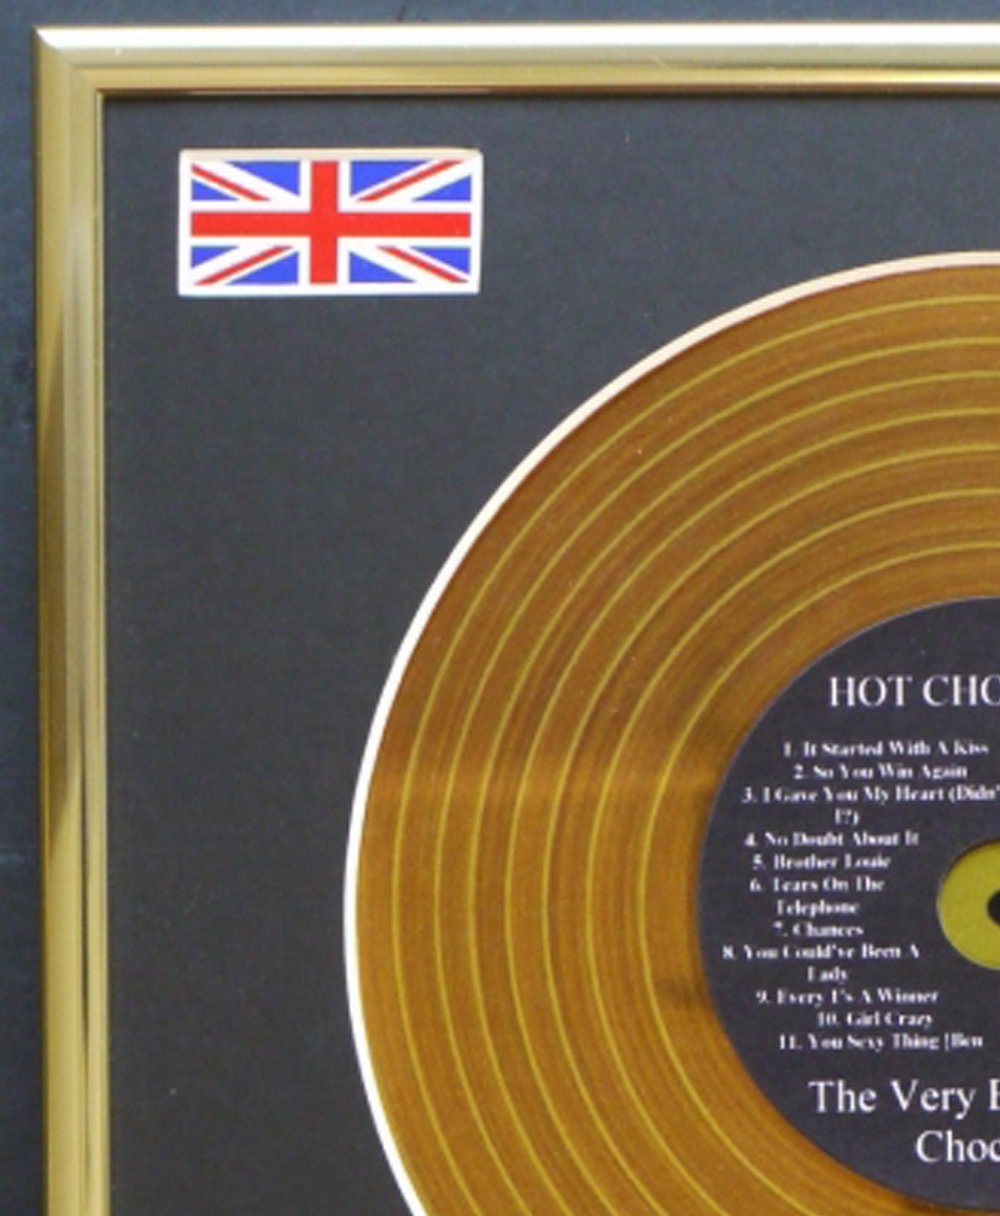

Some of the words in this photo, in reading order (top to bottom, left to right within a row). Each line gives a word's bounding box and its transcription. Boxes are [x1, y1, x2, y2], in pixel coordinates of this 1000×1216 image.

[829, 675, 913, 707] HOT
[804, 741, 815, 756] It
[822, 740, 882, 756] Started
[888, 740, 929, 756] With
[937, 740, 948, 756] A
[953, 739, 989, 755] Kiss
[813, 764, 833, 780] So
[840, 764, 873, 779] You
[878, 763, 913, 779] Win
[918, 763, 967, 780] Again
[763, 788, 770, 803] I
[774, 787, 817, 803] Gave
[823, 787, 858, 802] You
[864, 787, 889, 805] My
[896, 786, 944, 801] Heart
[764, 832, 788, 847] No
[793, 831, 843, 847] Doubt
[851, 831, 898, 846] About
[905, 830, 919, 846] It
[773, 854, 837, 870] Brother
[845, 854, 891, 869] Louie
[773, 877, 819, 892] Tears
[822, 876, 849, 892] On
[856, 875, 886, 892] The
[777, 900, 859, 918] Telephone
[793, 921, 864, 937] Chances
[743, 945, 778, 960] You
[783, 943, 855, 960] Could've
[862, 943, 901, 959] Been
[909, 943, 919, 959] A
[807, 966, 848, 985] Lady
[777, 988, 823, 1008] Every
[861, 988, 872, 1004] A
[877, 987, 939, 1004] Winner
[847, 1011, 880, 1027] Girl
[884, 1011, 933, 1030] Crazy
[807, 1034, 842, 1049] You
[847, 1034, 884, 1052] Sexy
[892, 1032, 939, 1050] Thing
[808, 1079, 878, 1114] The
[890, 1079, 975, 1120] Very
